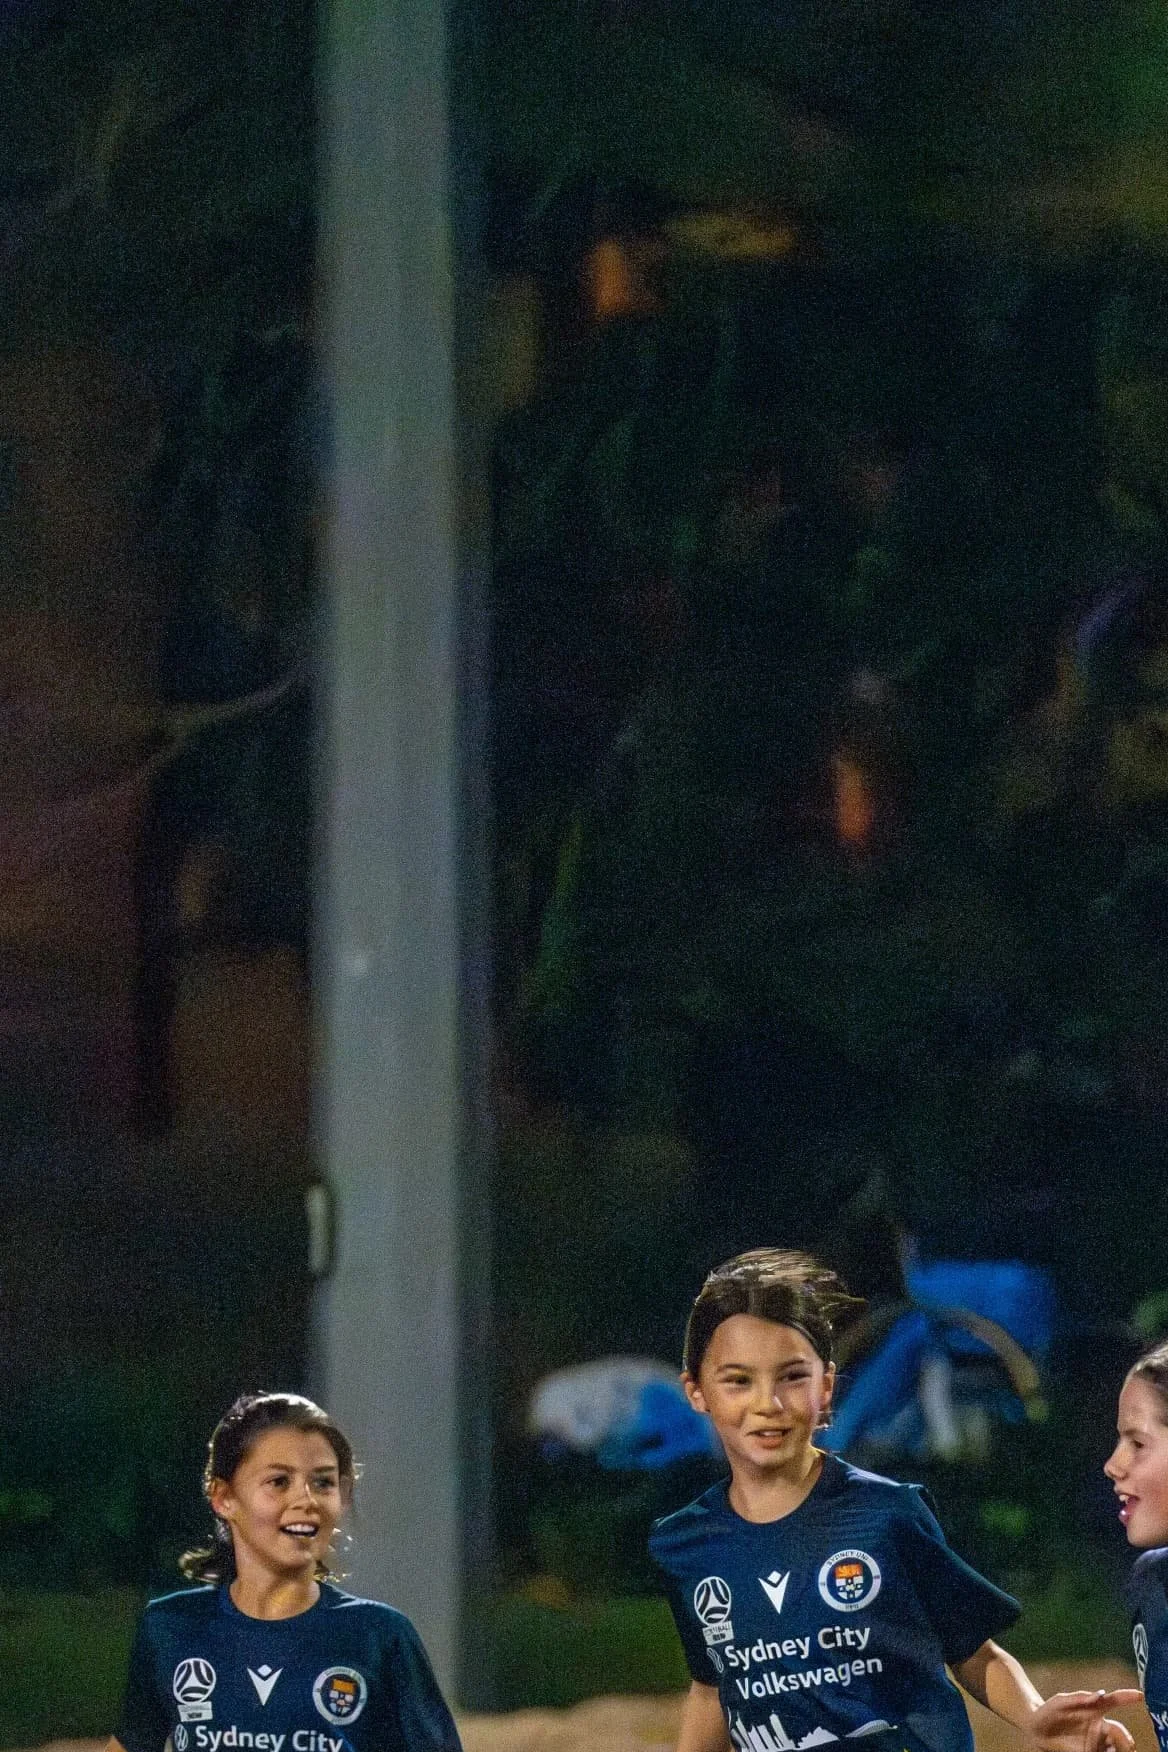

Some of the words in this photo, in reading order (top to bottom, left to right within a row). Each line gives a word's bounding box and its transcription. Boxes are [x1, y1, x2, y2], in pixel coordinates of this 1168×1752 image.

[725, 1636, 810, 1670] Sydney
[818, 1626, 871, 1651] City
[736, 1657, 883, 1700] Volkswagen
